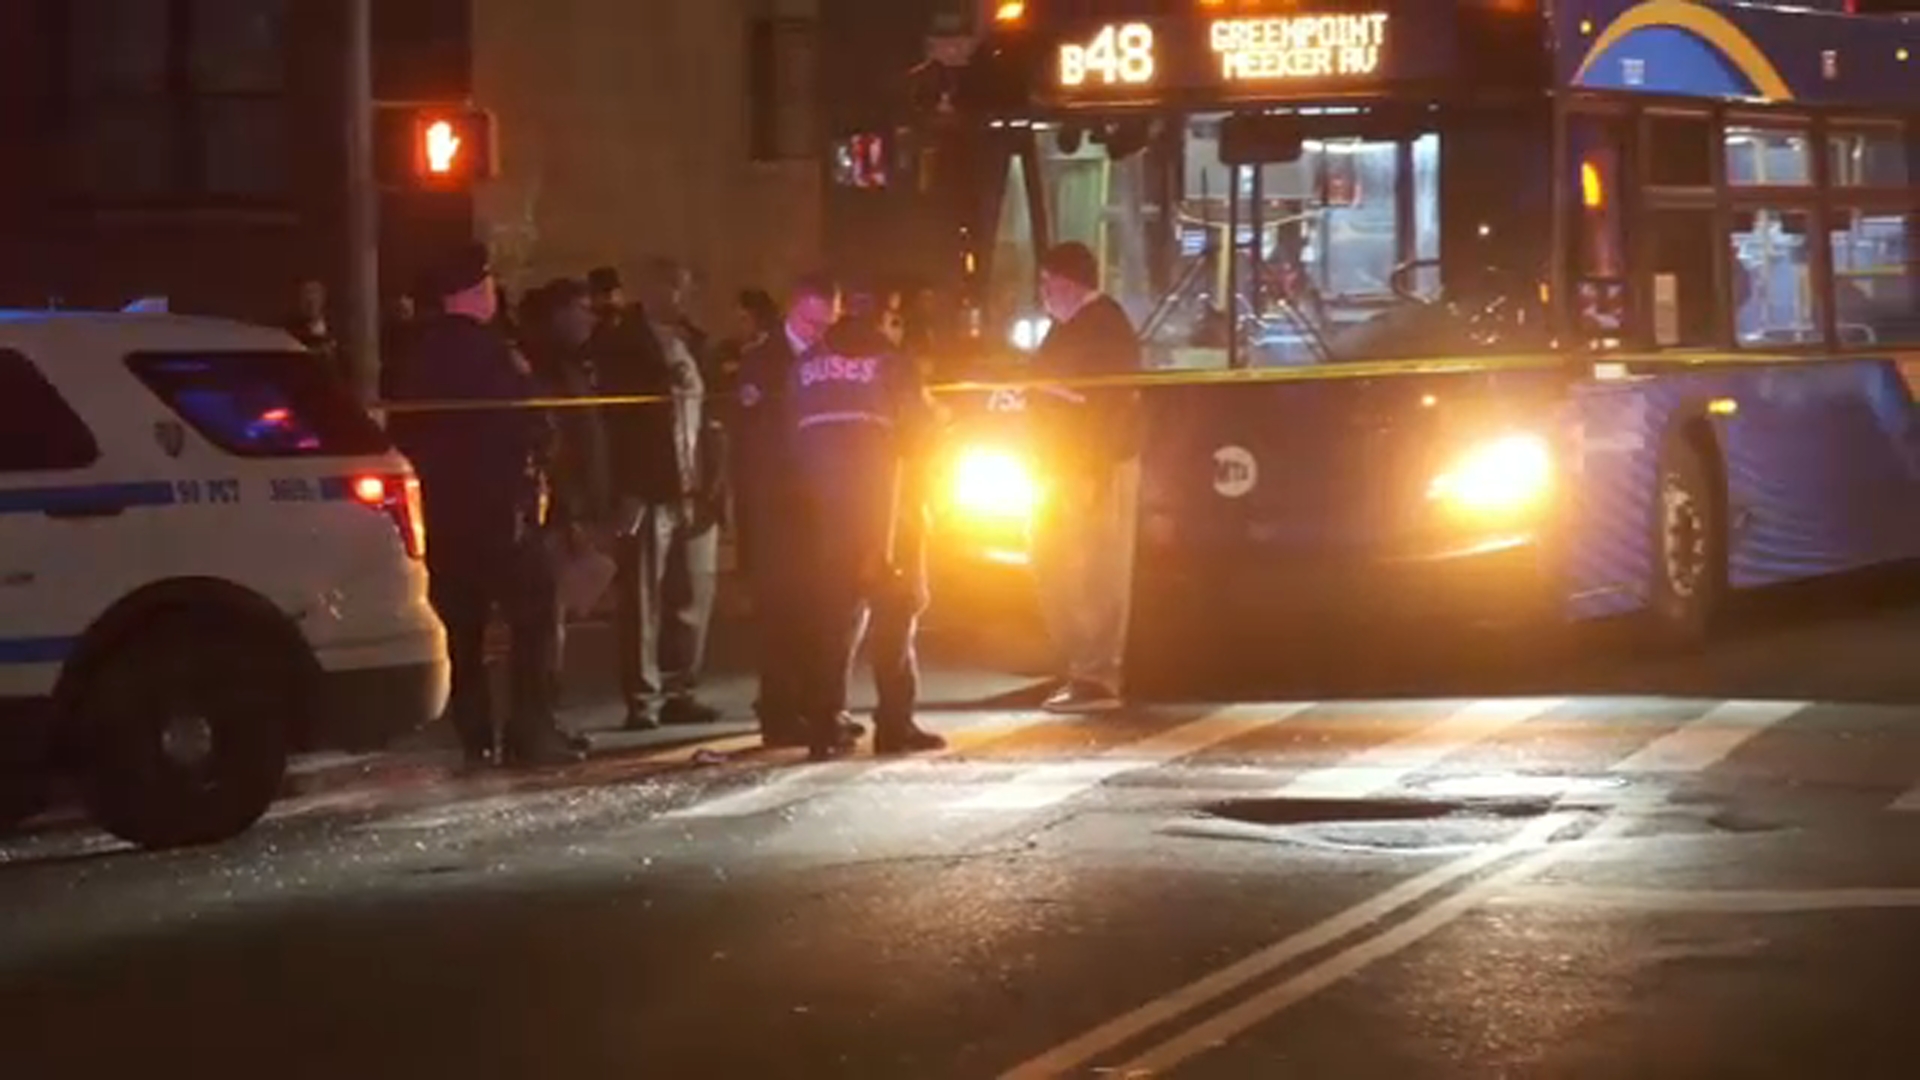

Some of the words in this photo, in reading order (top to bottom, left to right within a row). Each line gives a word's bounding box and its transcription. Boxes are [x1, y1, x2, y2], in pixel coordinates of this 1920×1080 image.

[1211, 13, 1388, 51] GREENPOINT
[1060, 22, 1153, 84] B48
[1223, 49, 1331, 79] MEEKER
[1339, 46, 1378, 74] AV
[801, 355, 876, 385] BUSES
